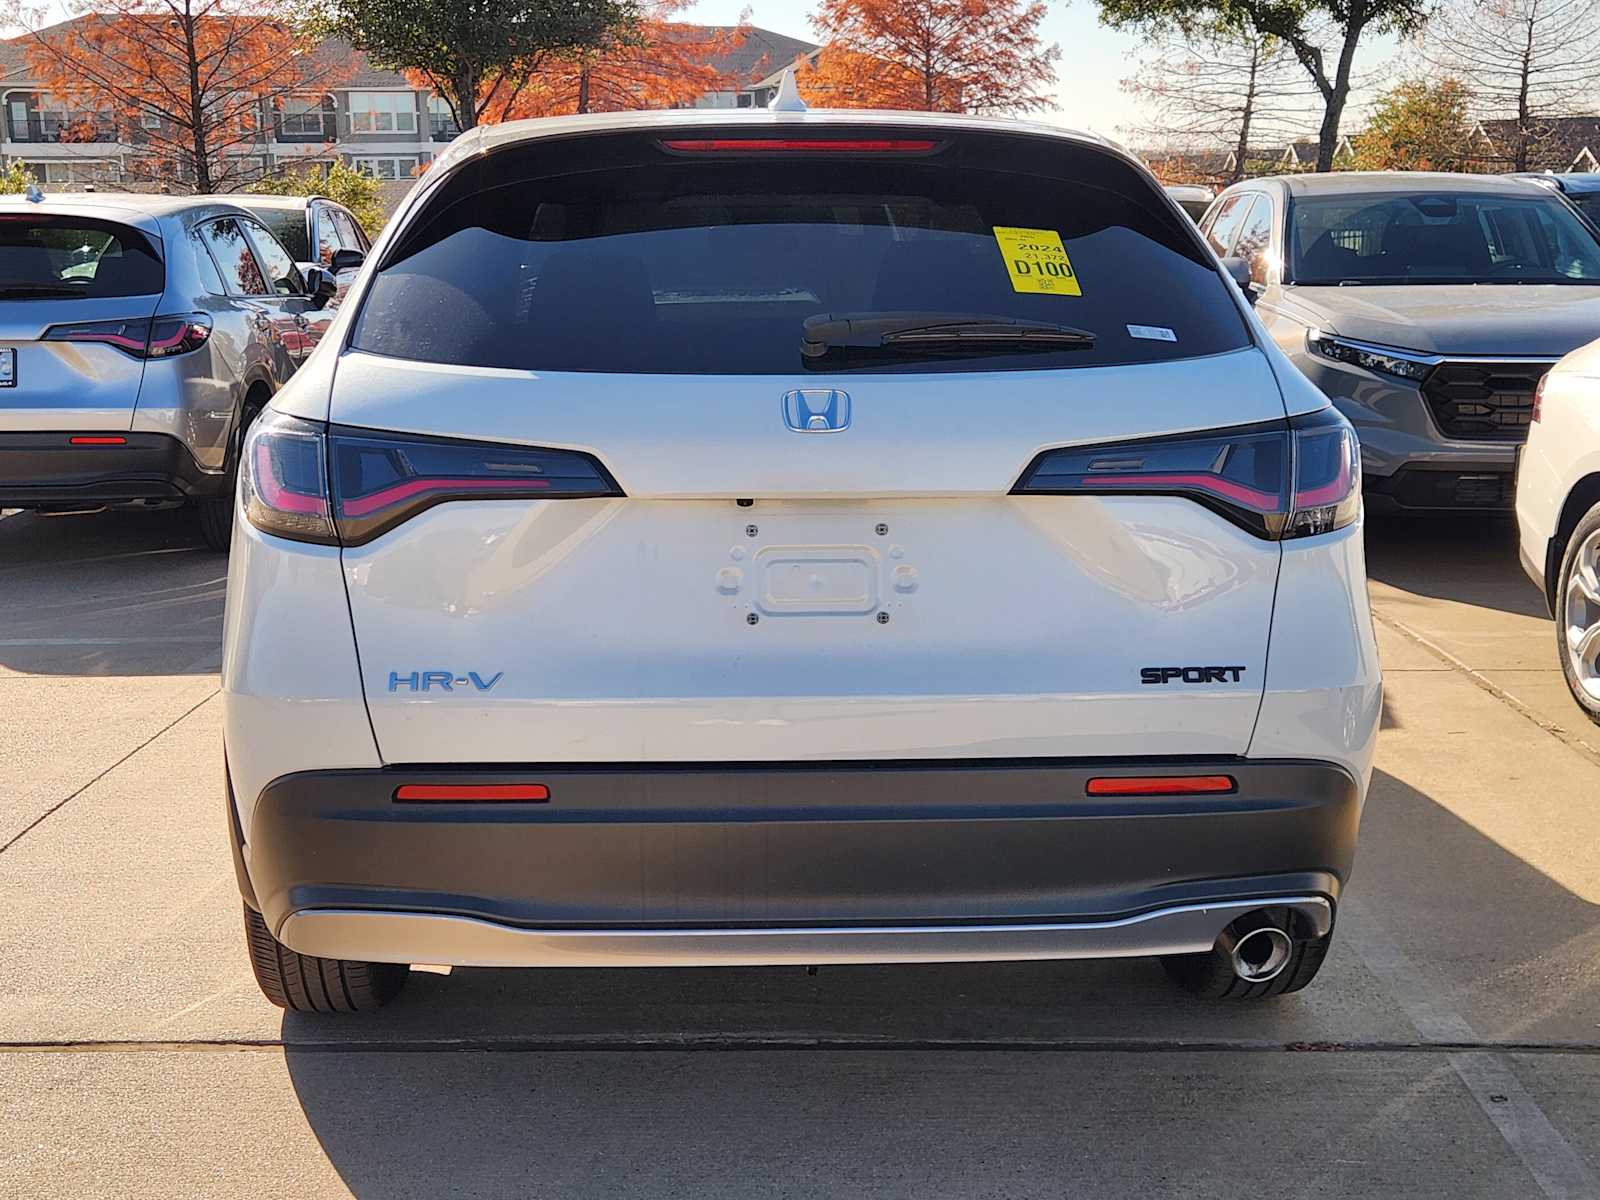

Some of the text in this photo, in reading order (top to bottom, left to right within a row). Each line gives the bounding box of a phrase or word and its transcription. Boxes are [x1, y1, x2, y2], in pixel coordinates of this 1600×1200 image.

[1018, 243, 1062, 253] 2024
[1014, 259, 1073, 278] D100
[388, 671, 504, 692] HR-V
[1140, 666, 1246, 684] SPORT
